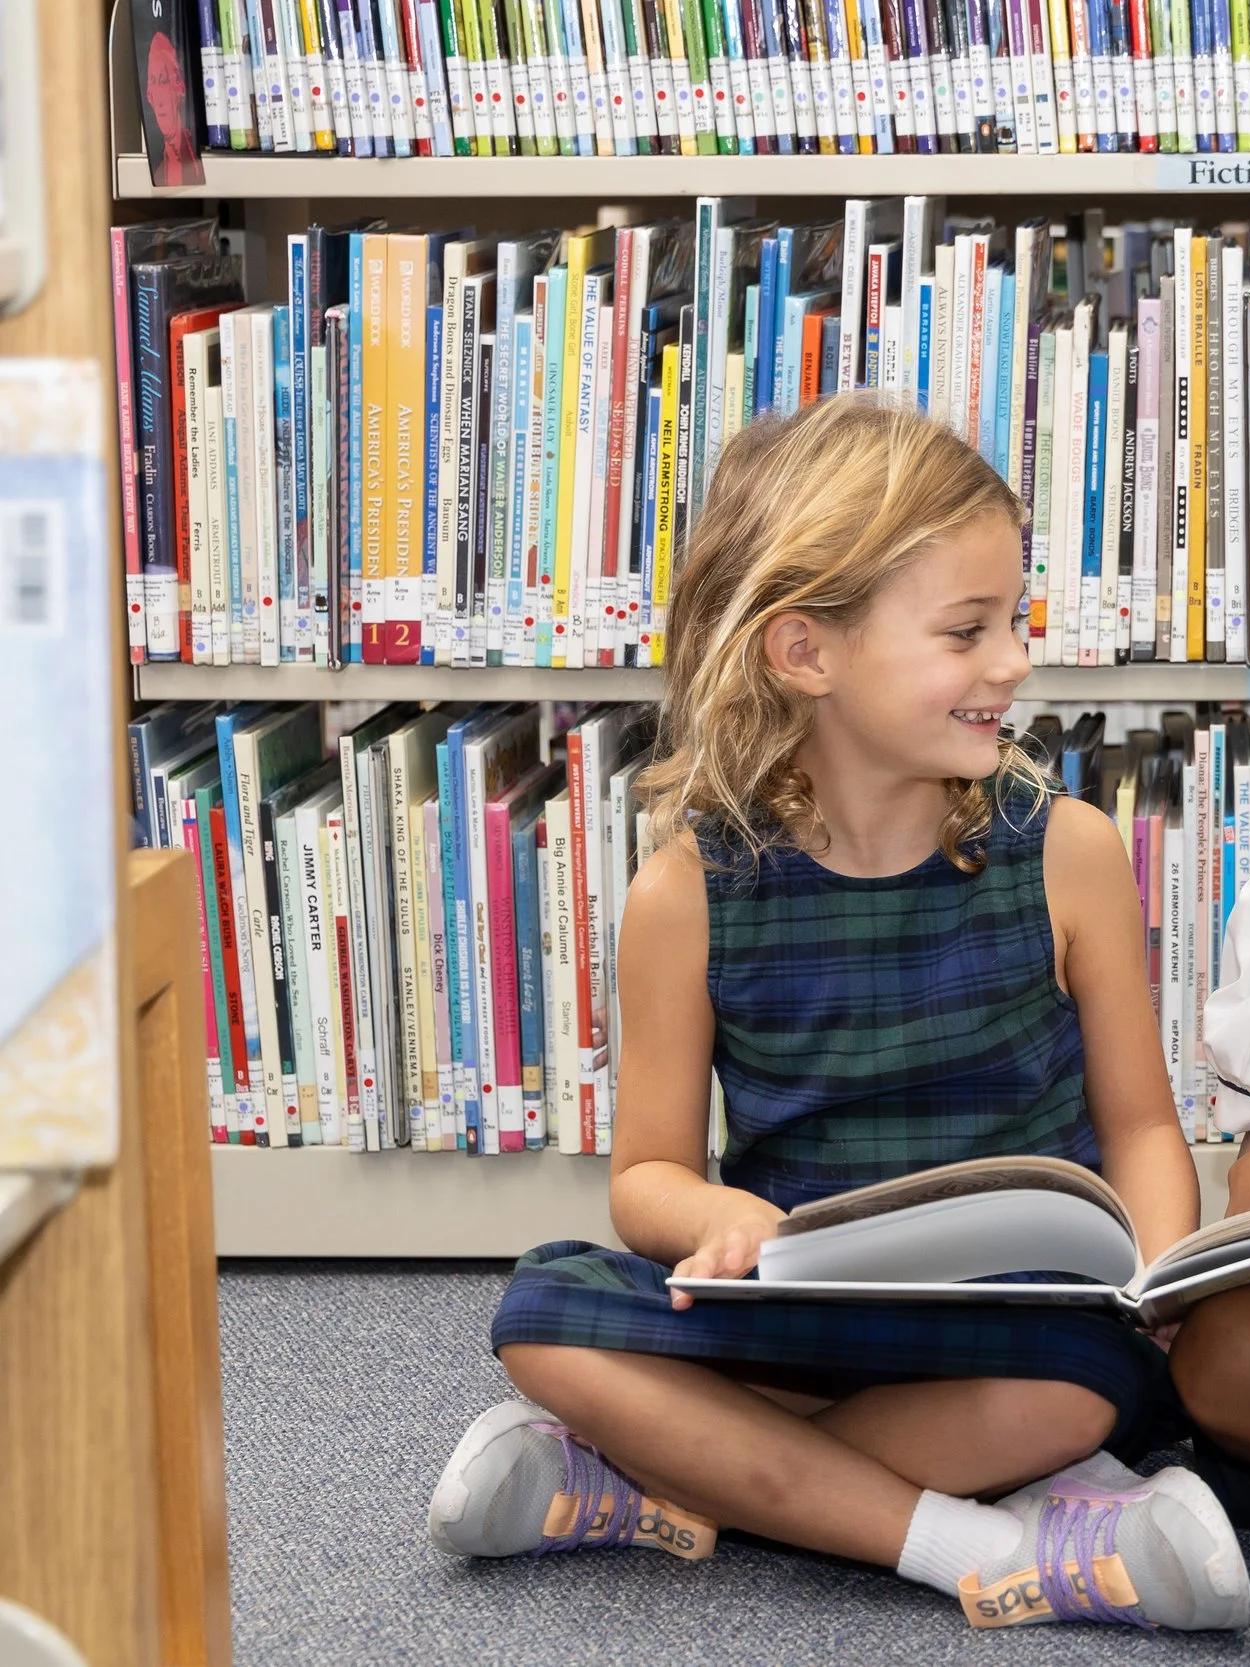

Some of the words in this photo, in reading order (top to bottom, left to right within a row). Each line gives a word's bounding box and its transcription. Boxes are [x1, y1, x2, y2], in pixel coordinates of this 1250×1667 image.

[585, 278, 597, 302] THE
[870, 260, 879, 289] JAVAKA
[1194, 272, 1204, 311] LOUIS
[137, 275, 157, 354] Samuel
[445, 276, 458, 318] Dragon
[463, 290, 475, 318] RYAN
[870, 291, 879, 324] STEPTOE
[936, 286, 949, 336] ALWAYS
[446, 322, 456, 353] Bones
[500, 317, 511, 341] THE
[583, 306, 596, 348] VALUE
[920, 303, 929, 359] BARASCH
[1193, 314, 1203, 366] BRAILLE
[1227, 281, 1239, 366] THROUGH
[462, 332, 474, 383] SELZNICK
[582, 352, 594, 371] OF
[682, 344, 692, 382] KENDALL
[776, 335, 784, 354] THE
[445, 356, 455, 378] and
[498, 344, 510, 390] SECRET
[934, 338, 947, 400] INVENTING
[1128, 356, 1138, 384] POTTS
[141, 359, 161, 432] Adams
[189, 367, 199, 425] Remember
[444, 383, 455, 433] Dinosaur
[579, 374, 593, 434] FANTASY
[774, 376, 783, 405] SPACE
[1228, 378, 1239, 403] MY
[460, 397, 472, 438] WHEN
[496, 393, 508, 436] WORLD
[610, 401, 624, 439] SEED
[1073, 392, 1084, 433] WADE
[190, 428, 199, 445] the
[366, 402, 383, 491] AMERICA'S
[397, 403, 414, 491] AMERICA'S
[441, 437, 453, 464] Eggs
[496, 438, 507, 456] OF
[662, 420, 673, 448] NEIL
[1228, 416, 1239, 460] EYES
[144, 444, 157, 485] Fradin
[191, 447, 201, 478] Ladies
[458, 442, 471, 499] MARIAN
[610, 450, 623, 487] SEED
[1071, 438, 1082, 483] BOGGS
[1124, 429, 1136, 481] ANDREW
[1193, 444, 1202, 490] FRADIN
[124, 472, 133, 483] IN
[494, 460, 506, 509] WALTER
[659, 452, 672, 532] ARMSTRONG
[125, 485, 134, 510] EVERY
[146, 493, 156, 532] CLARION
[1122, 482, 1134, 532] JACKSON
[1228, 488, 1239, 544] BRIDGES
[126, 513, 136, 533] WAY
[193, 522, 203, 552] Ferris
[367, 496, 384, 580] PRESIDEN
[396, 498, 412, 576] PRESIDEN
[441, 498, 453, 542] Bausum
[457, 503, 470, 542] SANG
[147, 534, 157, 562] BOOKS
[492, 511, 505, 578] ANDERSON
[658, 538, 667, 564] SPACE
[657, 568, 666, 601] PIONEER
[1197, 751, 1208, 785] Diana:
[240, 773, 252, 802] Flora
[393, 767, 404, 810] SHAKA,
[242, 805, 253, 825] and
[396, 815, 405, 844] KING
[242, 829, 255, 856] Tiger
[397, 848, 406, 865] OF
[553, 837, 567, 857] Big
[303, 844, 318, 891] JIMMY
[398, 870, 407, 894] THE
[556, 860, 568, 897] Annie
[1171, 863, 1179, 876] 26
[1196, 858, 1206, 902] Princess
[252, 909, 264, 938] Carle
[306, 895, 322, 951] CARTER
[399, 898, 410, 935] ZULUS
[557, 900, 568, 911] of
[1171, 878, 1179, 938] FAIRMOUNT
[433, 933, 444, 956] Dick
[558, 913, 570, 965] Calumet
[431, 959, 446, 994] Cheney
[1196, 972, 1206, 1010] Richard
[318, 1016, 331, 1057] Schraff
[403, 967, 417, 1078] STANLEY/VENNEMA
[560, 1000, 572, 1036] Stanley
[1196, 1013, 1205, 1042] Wood
